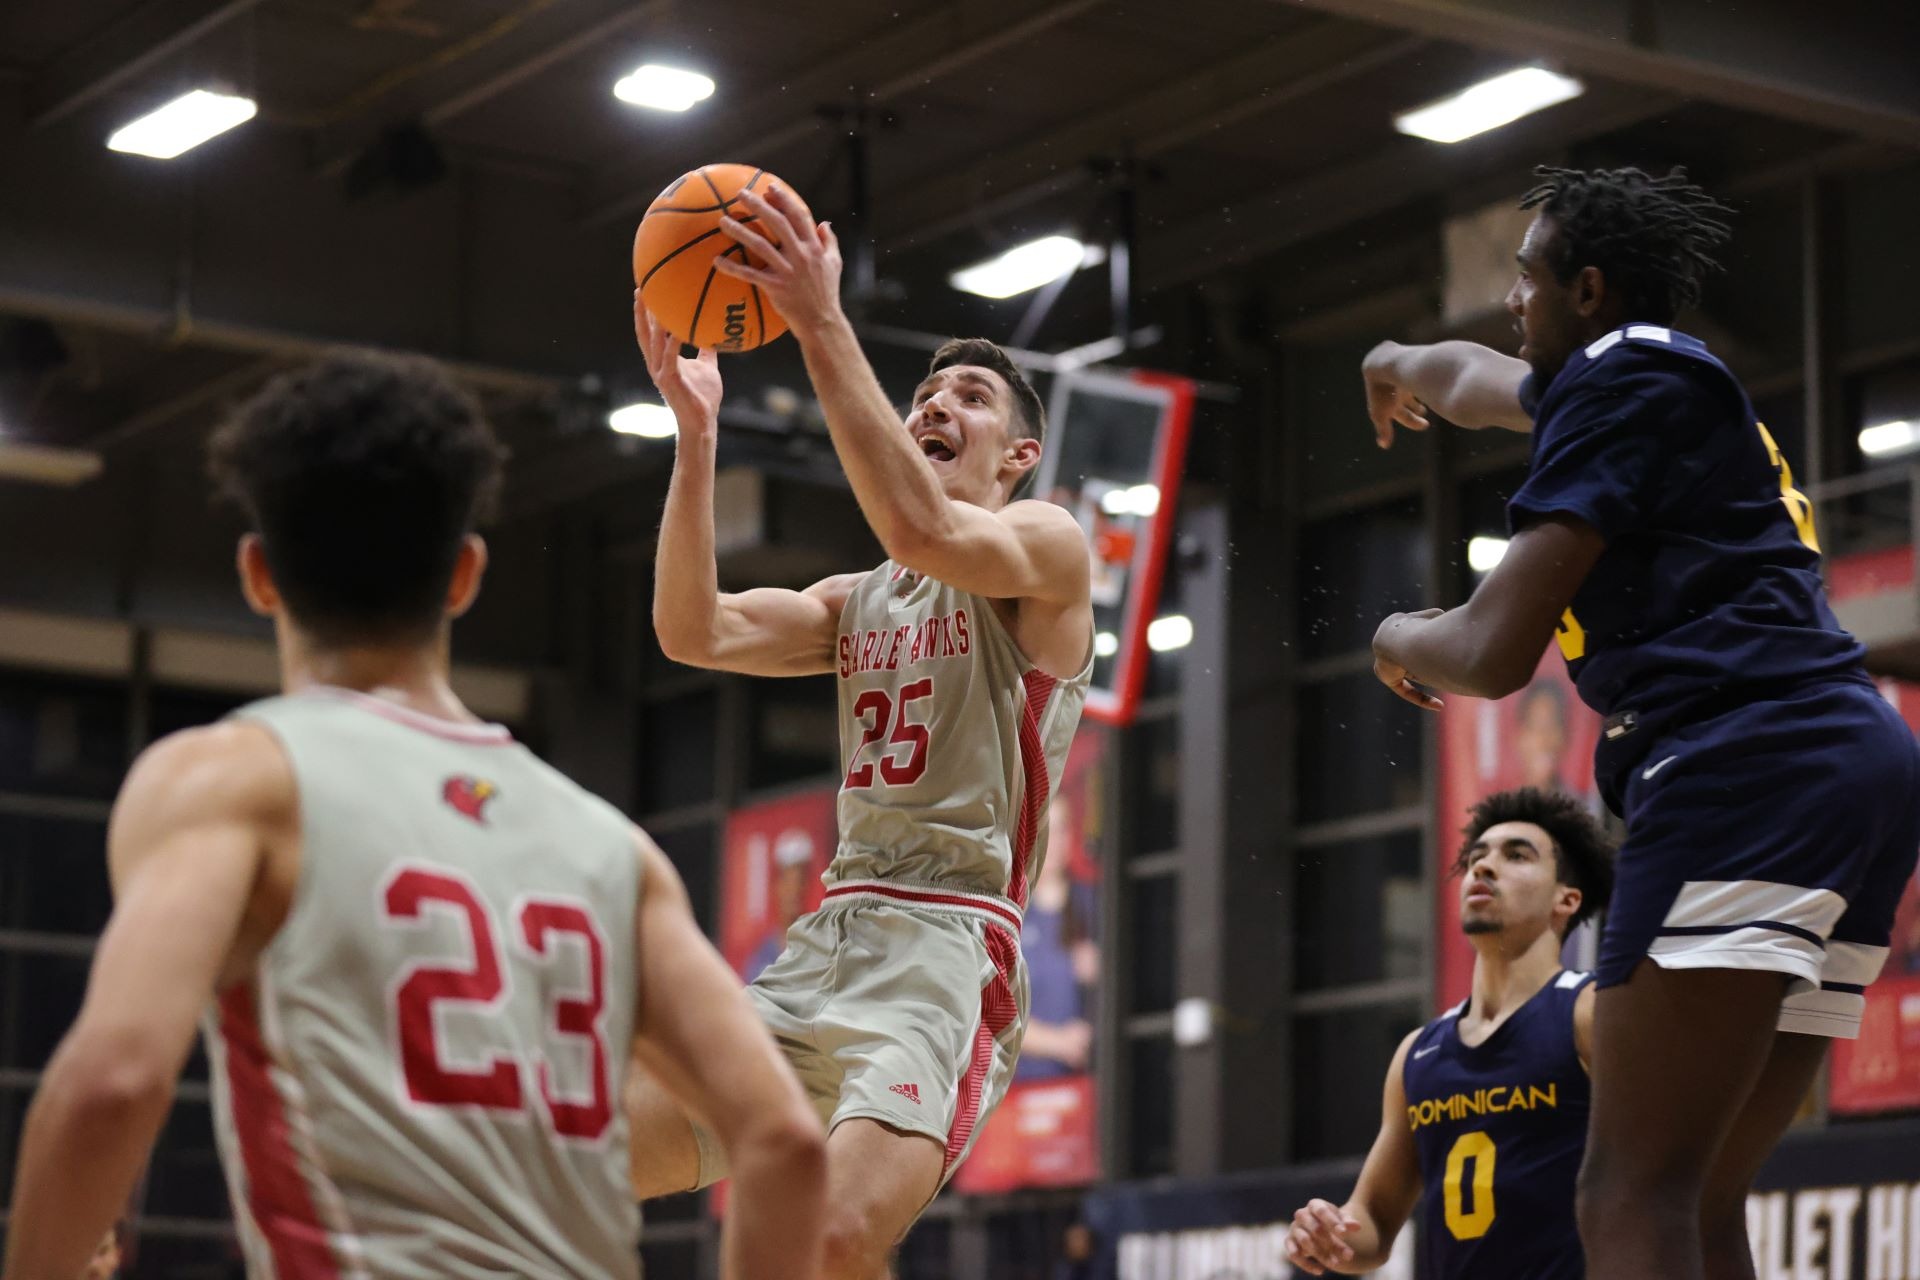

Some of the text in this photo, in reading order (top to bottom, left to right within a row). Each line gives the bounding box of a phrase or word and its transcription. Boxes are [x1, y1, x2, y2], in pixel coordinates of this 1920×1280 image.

[843, 676, 935, 791] 25
[382, 862, 615, 1142] 23
[1407, 1082, 1557, 1131] DOMINICAN
[1442, 1130, 1497, 1241] 0
